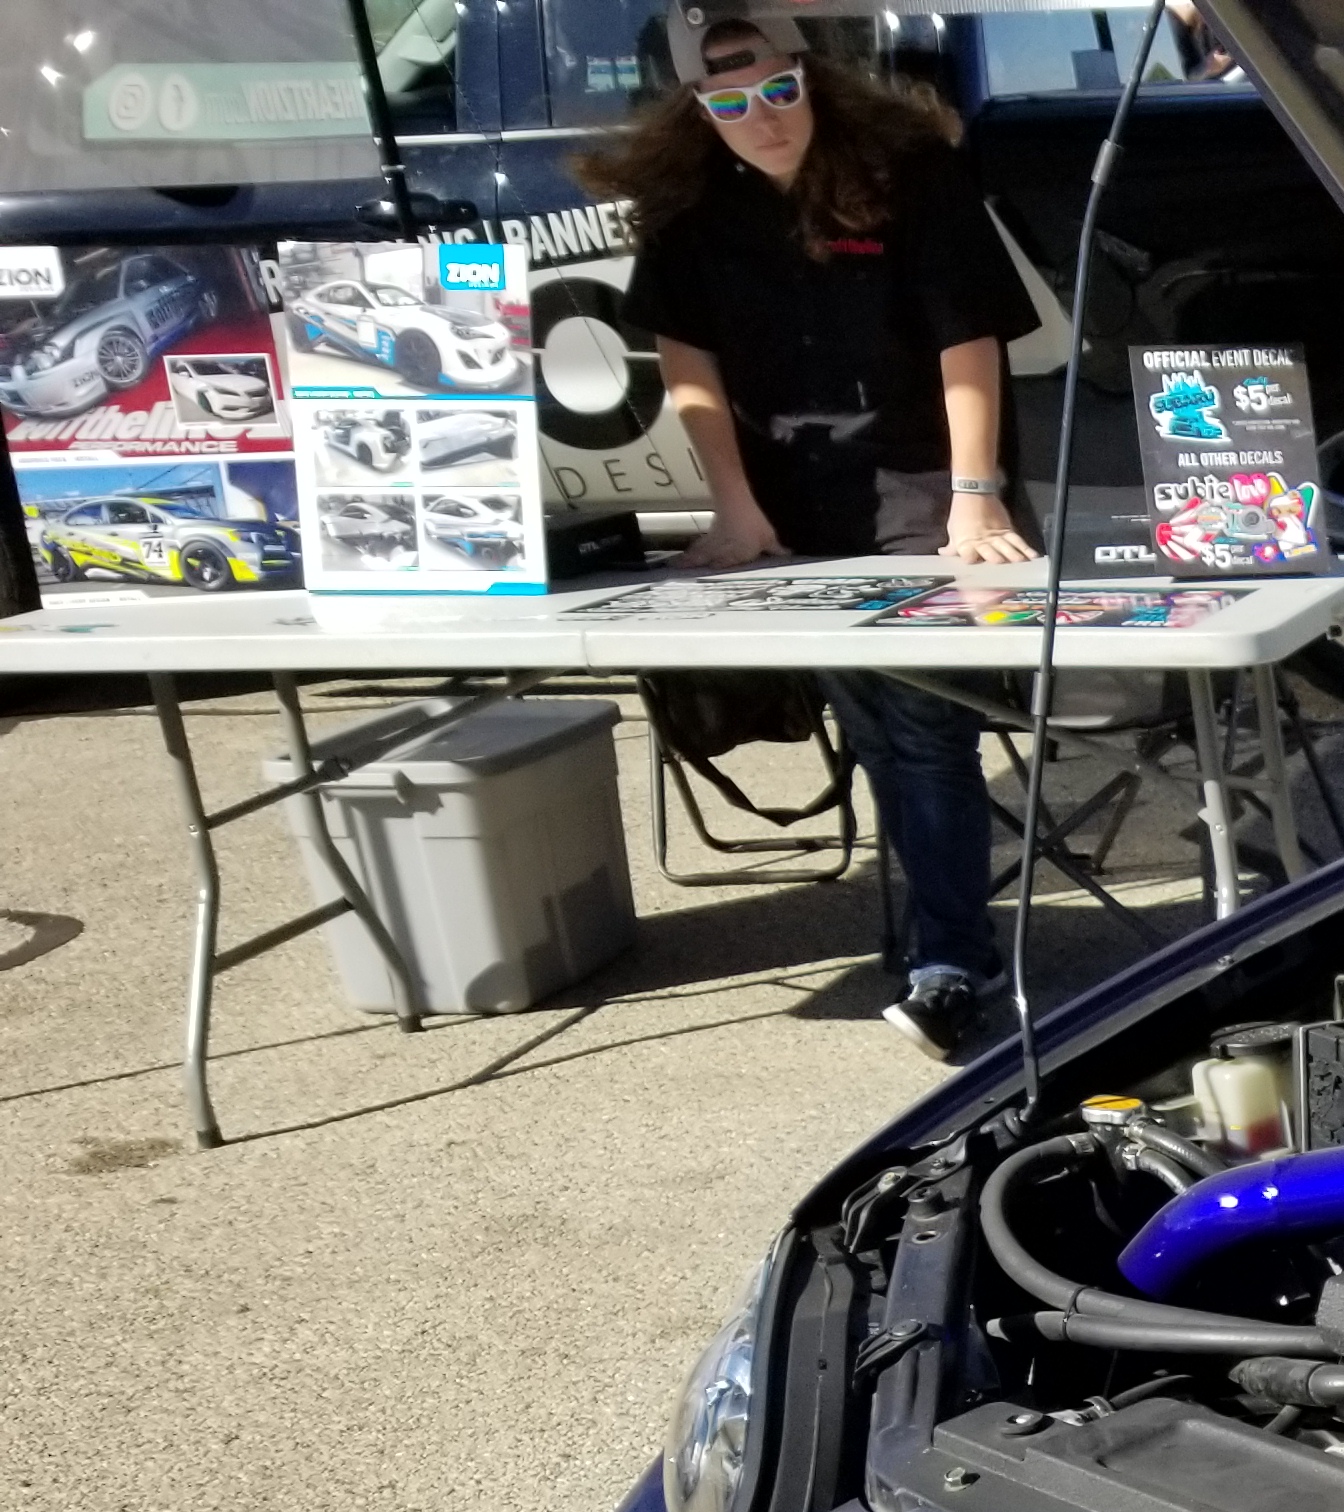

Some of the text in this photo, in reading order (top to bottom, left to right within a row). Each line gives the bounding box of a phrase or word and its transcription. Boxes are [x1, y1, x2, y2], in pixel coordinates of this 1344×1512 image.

[503, 201, 640, 260] BANNE
[446, 263, 500, 283] ZION
[1143, 351, 1210, 369] OFFICIAL
[1211, 350, 1250, 367] EVENT
[1233, 384, 1267, 410] $5
[1178, 451, 1283, 467] ALL OTHER DECALS
[141, 539, 164, 559] 74
